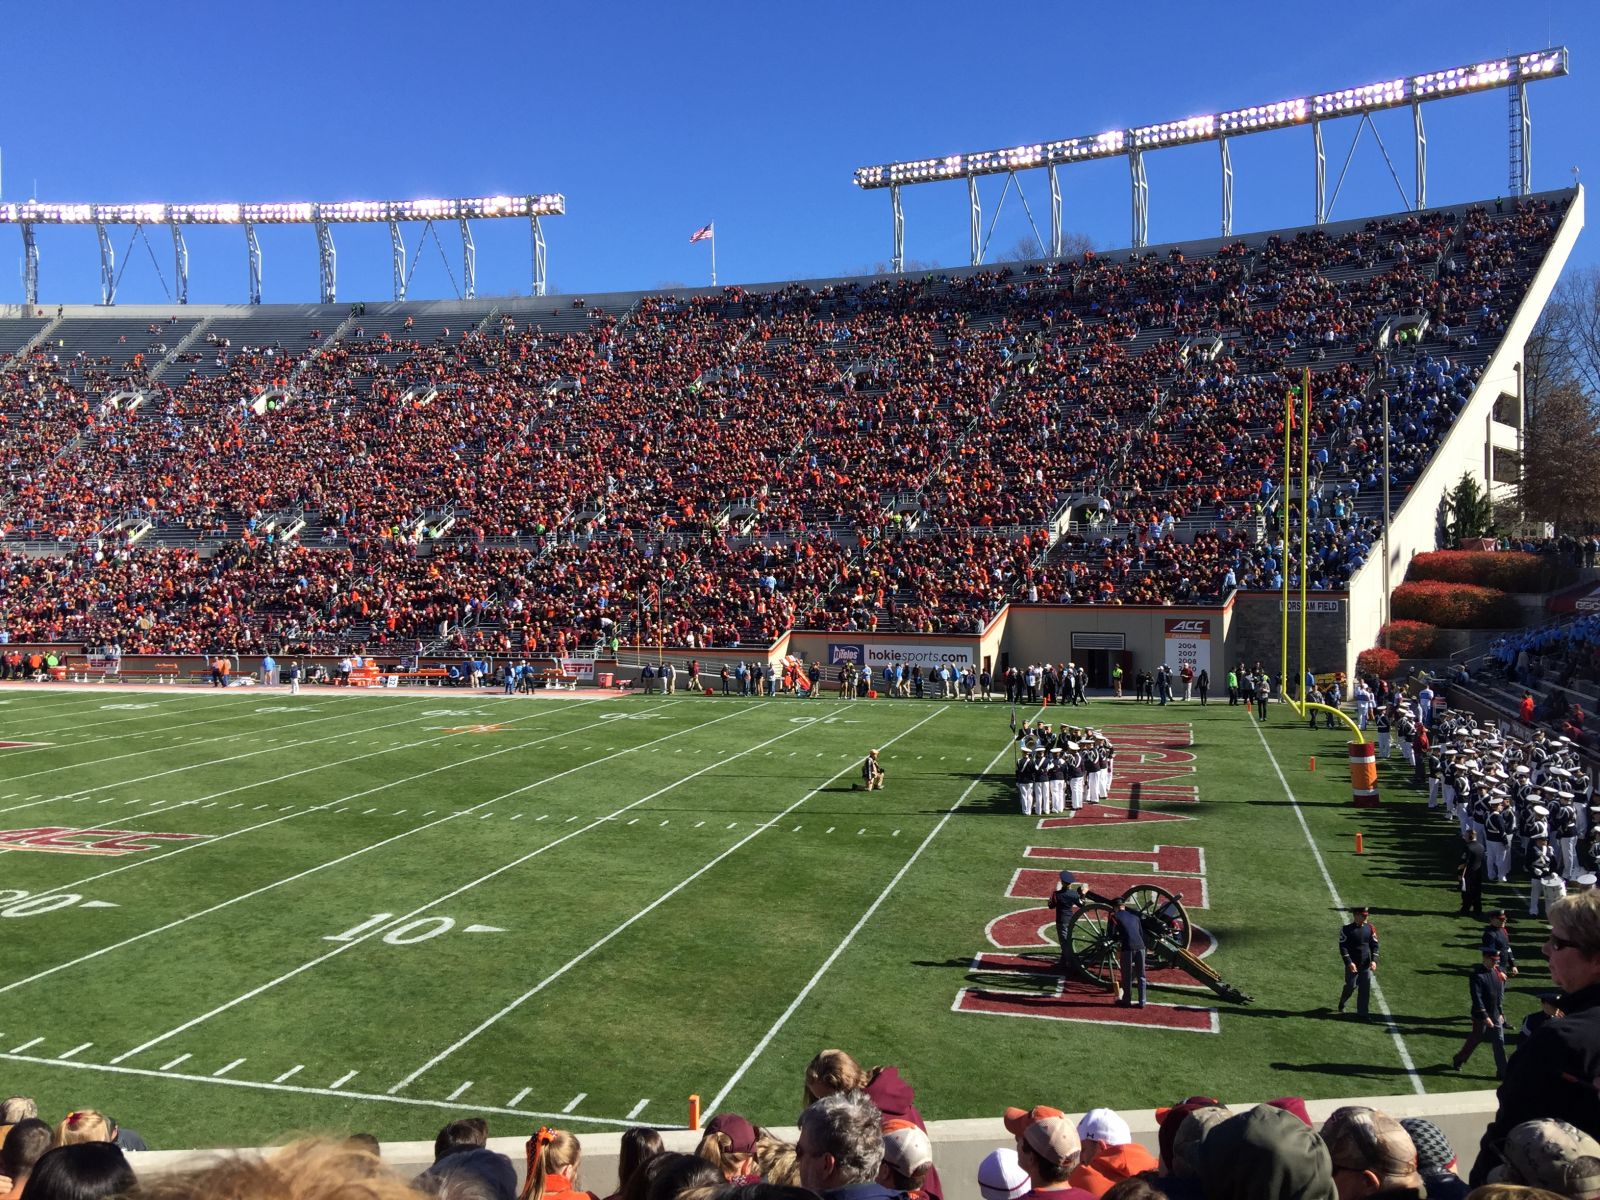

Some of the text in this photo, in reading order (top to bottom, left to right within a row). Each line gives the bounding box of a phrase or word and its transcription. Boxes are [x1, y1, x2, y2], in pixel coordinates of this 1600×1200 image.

[1281, 602, 1337, 610] ORSAM FIELD
[1172, 620, 1205, 630] ACC
[869, 649, 968, 666] hokiesports.com
[563, 663, 593, 673] ESPN
[322, 912, 457, 945] 10
